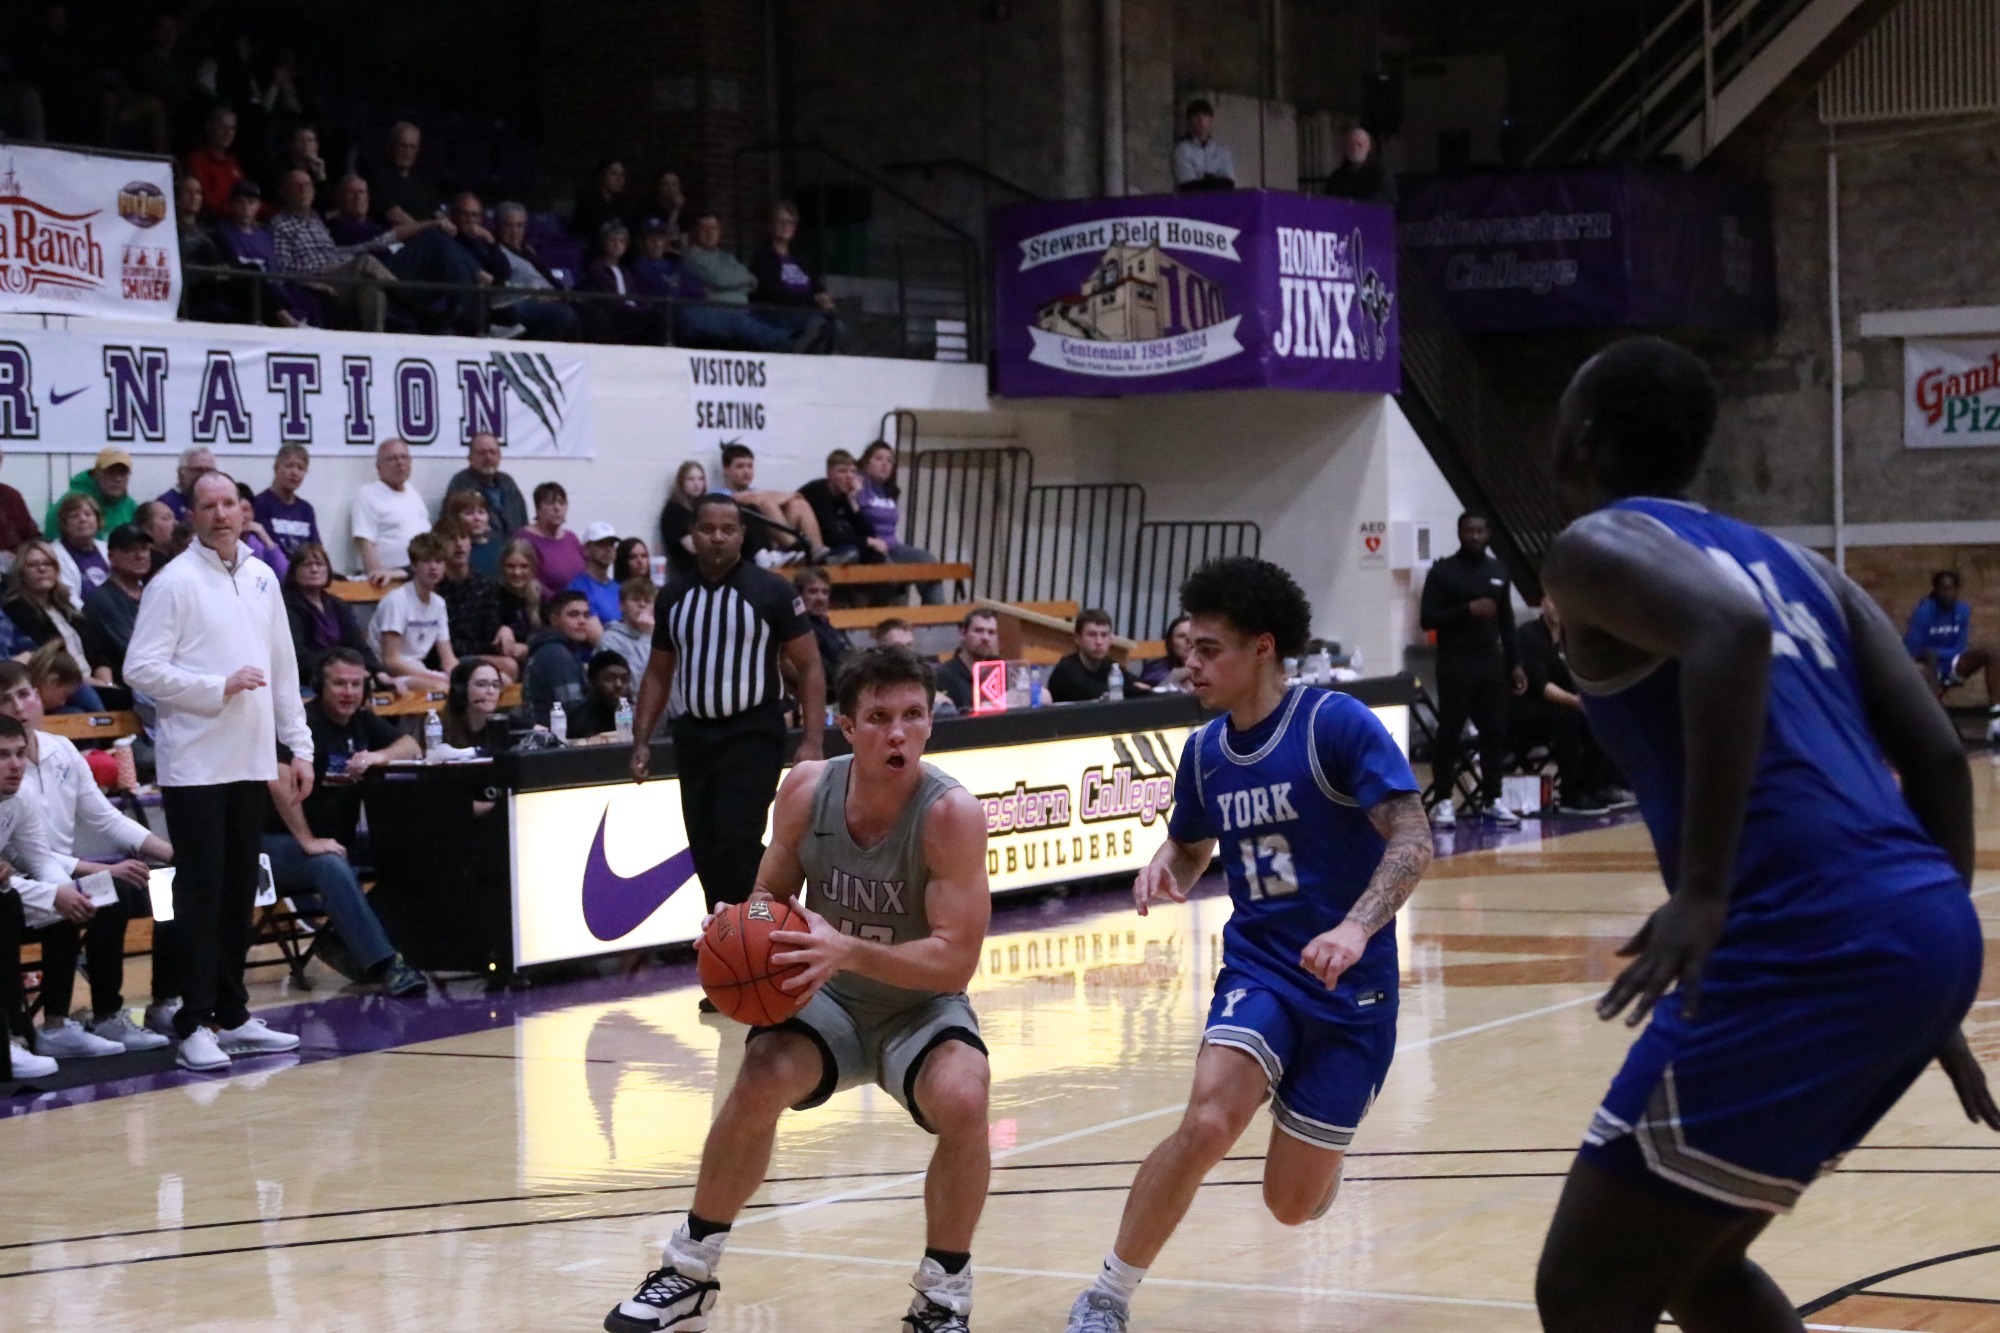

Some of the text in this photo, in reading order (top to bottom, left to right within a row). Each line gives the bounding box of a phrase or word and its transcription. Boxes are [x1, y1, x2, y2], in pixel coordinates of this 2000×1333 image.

[13, 209, 104, 278] Ranch
[1029, 221, 1228, 262] Stewart Field House
[1276, 226, 1339, 278] HOME
[1273, 277, 1356, 360] JINX
[690, 356, 767, 387] VISITORS
[1060, 339, 1137, 361] Centennial
[102, 343, 509, 446] NATION
[696, 401, 766, 430] SEATING
[1361, 521, 1386, 534] AED
[1080, 763, 1173, 827] College
[1216, 781, 1299, 831] YORK
[822, 866, 909, 915] JINX
[1239, 833, 1300, 901] 13
[1220, 987, 1247, 1017] Y
